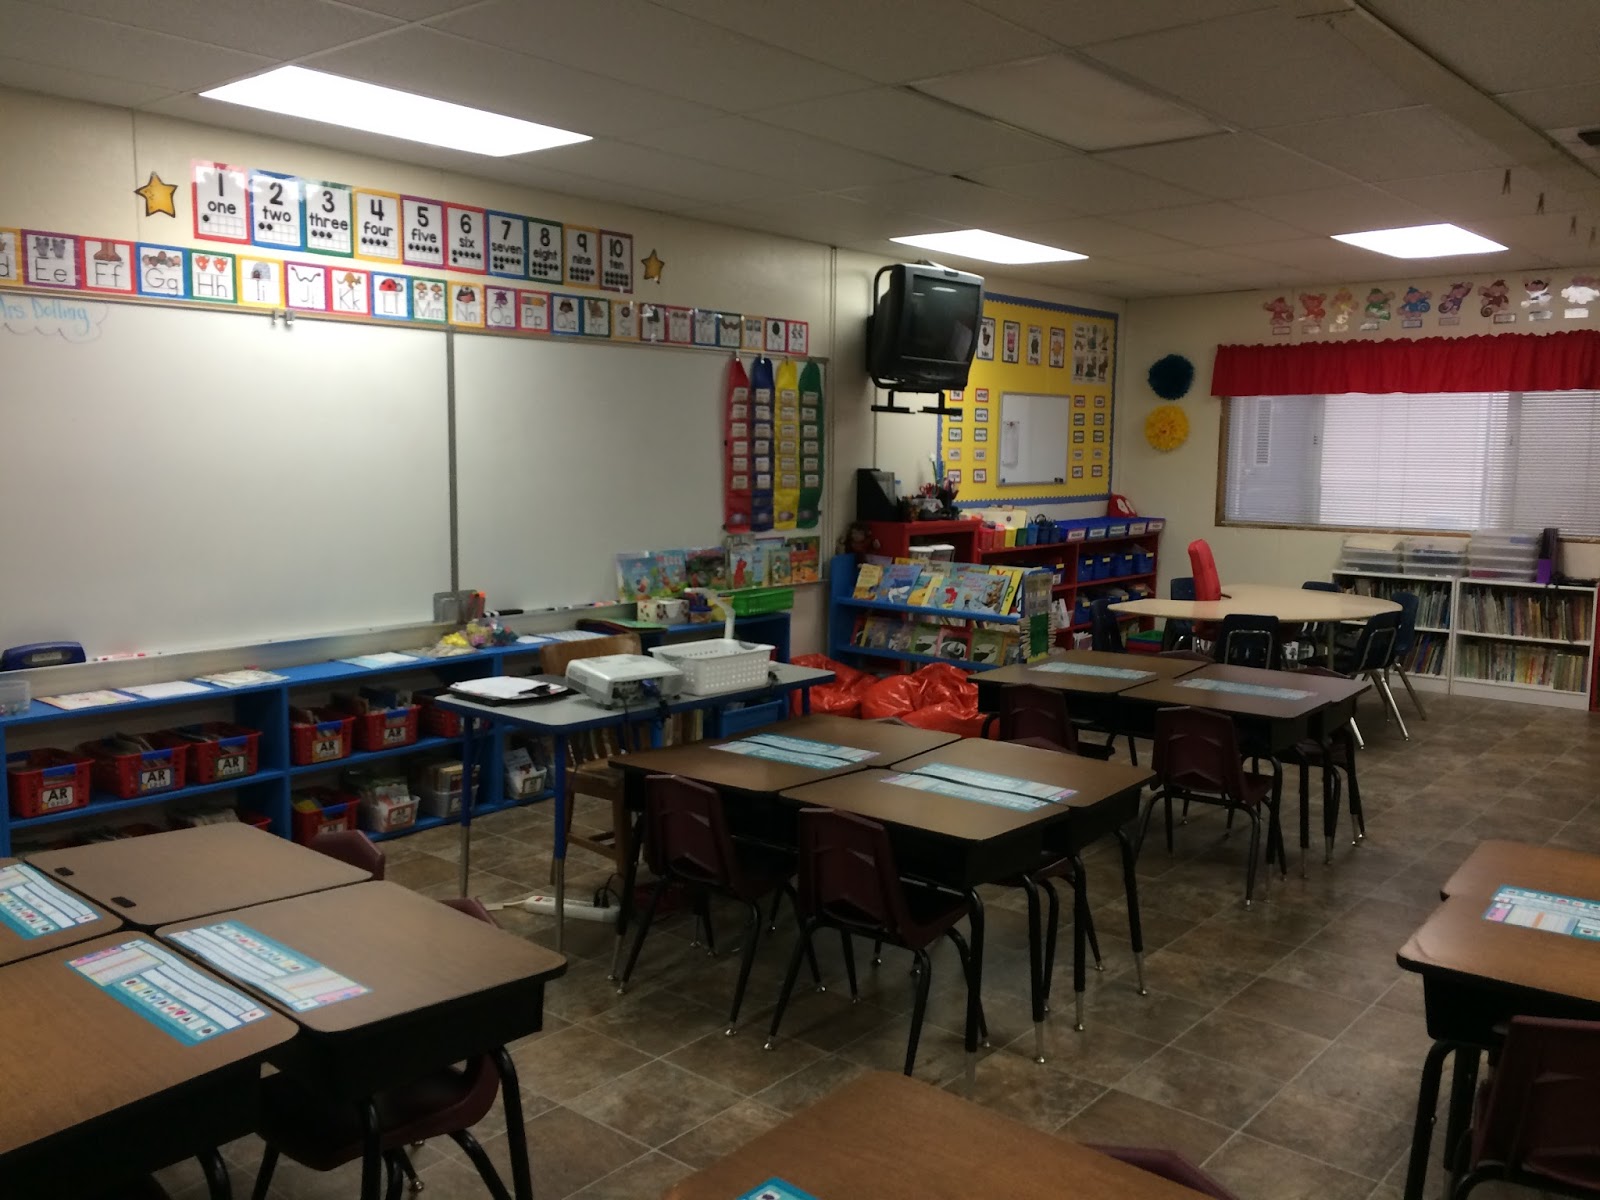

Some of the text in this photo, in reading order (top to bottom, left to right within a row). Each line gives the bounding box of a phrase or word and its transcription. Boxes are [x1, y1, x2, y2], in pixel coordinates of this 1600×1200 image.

[269, 182, 283, 206] 2
[322, 191, 335, 213] 3
[208, 201, 236, 214] one
[262, 206, 291, 222] two
[371, 199, 384, 221] 4
[417, 206, 429, 227] 5
[309, 213, 348, 230] three
[364, 221, 393, 237] four
[460, 214, 472, 234] 6
[501, 220, 511, 240] 7
[411, 228, 437, 243] five
[459, 237, 475, 249] six
[540, 227, 551, 247] 8
[577, 233, 587, 253] 9
[491, 242, 522, 255] seven
[533, 248, 558, 261] eight
[609, 239, 623, 258] 10
[35, 256, 67, 282] Ee
[572, 255, 592, 266] nine
[609, 260, 624, 270] ten
[95, 262, 123, 287] Ff
[145, 268, 178, 297] Gg
[197, 272, 228, 298] Hh
[339, 287, 361, 310] Kk
[456, 303, 477, 322] Nn
[525, 307, 543, 328] Pp
[320, 741, 336, 752] AR
[224, 756, 239, 769] AR
[147, 769, 165, 783] AR
[48, 788, 68, 802] AR
